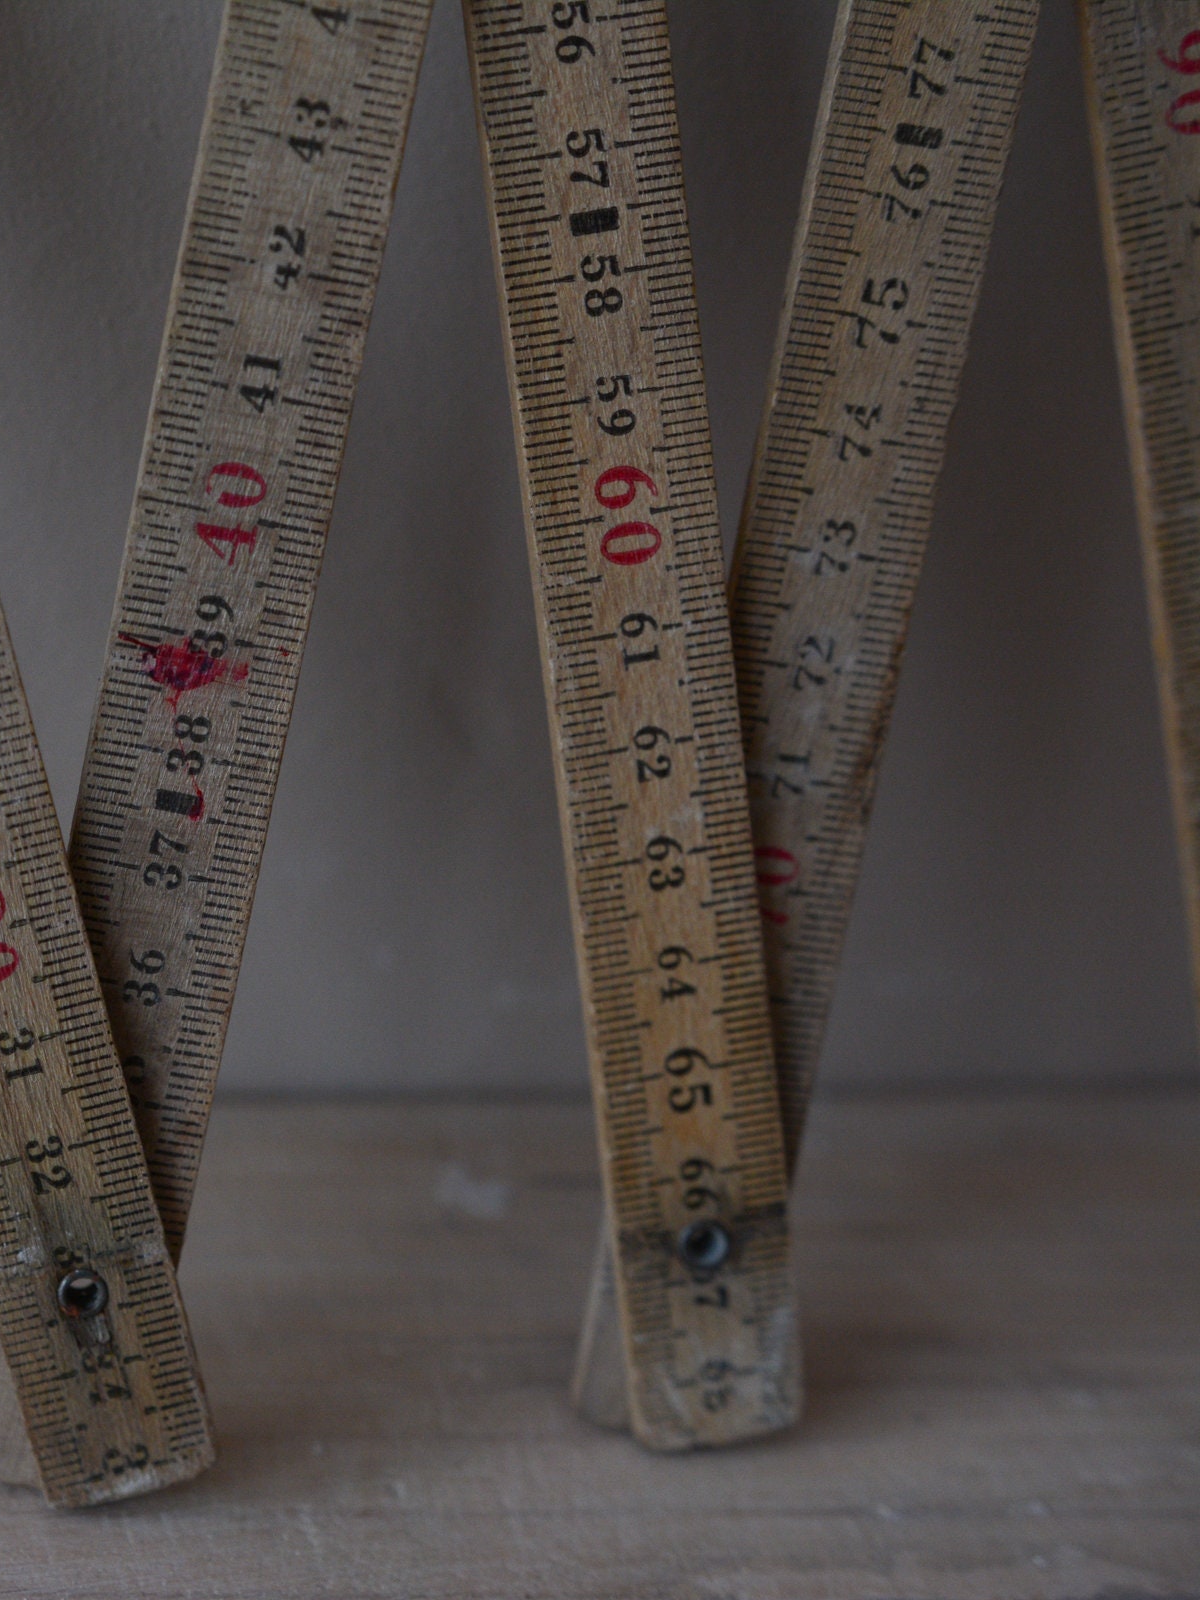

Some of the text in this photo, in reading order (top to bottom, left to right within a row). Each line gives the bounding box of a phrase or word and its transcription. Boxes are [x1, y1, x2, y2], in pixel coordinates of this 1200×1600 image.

[551, 0, 595, 64] 56
[908, 34, 956, 100] 77
[286, 97, 332, 164] 43
[566, 128, 611, 188] 57
[881, 162, 930, 227] 76
[269, 223, 308, 292] 42
[580, 254, 623, 318] 58
[855, 276, 910, 351] 75
[238, 353, 282, 414] 41
[596, 373, 636, 437] 59
[838, 403, 883, 463] 74
[196, 461, 268, 567] 40
[594, 464, 662, 567] 60
[814, 517, 858, 577] 73
[190, 594, 235, 658] 39
[619, 612, 662, 672] 61
[792, 633, 836, 693] 72
[165, 714, 213, 777] 38
[633, 724, 673, 784] 62
[770, 750, 811, 801] 71
[143, 829, 193, 891] 37
[645, 835, 687, 893] 63
[123, 948, 167, 1008] 36
[656, 943, 698, 1004] 64
[662, 1046, 714, 1115] 65
[25, 1135, 73, 1196] 32
[679, 1156, 720, 1212] 66
